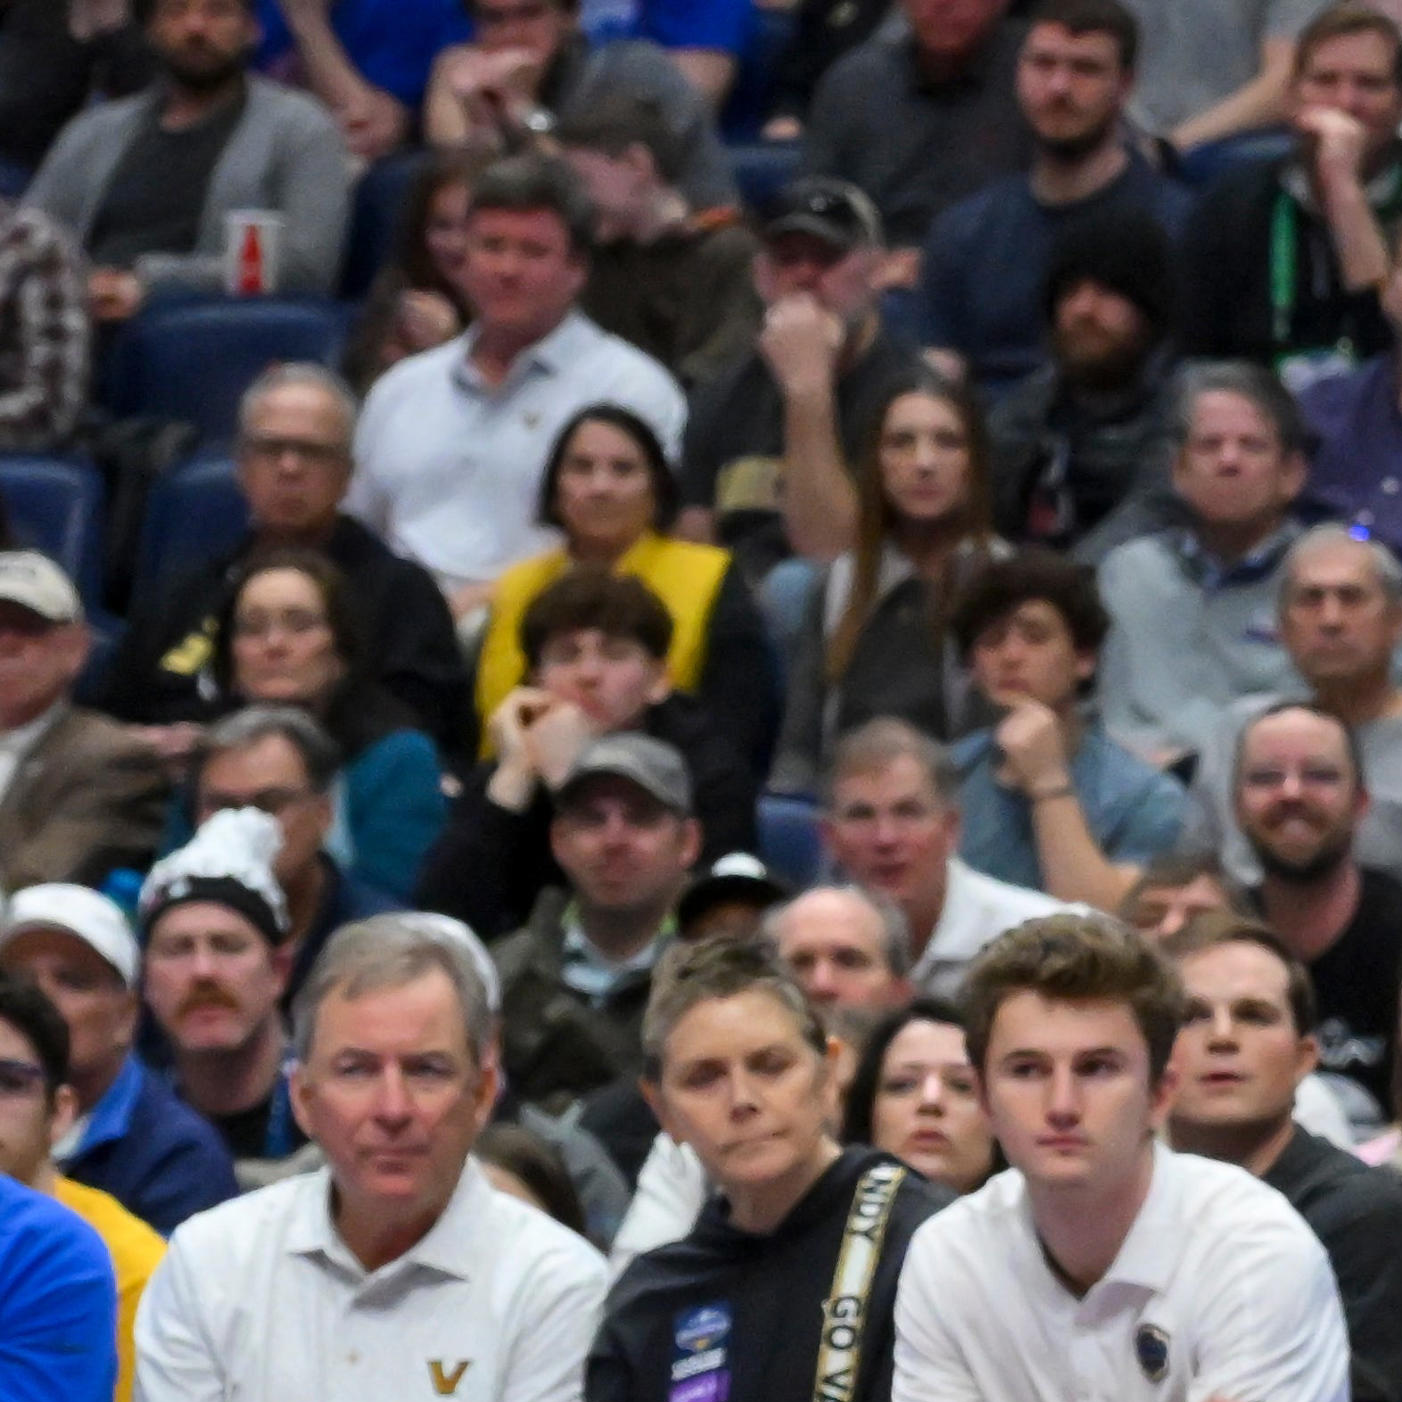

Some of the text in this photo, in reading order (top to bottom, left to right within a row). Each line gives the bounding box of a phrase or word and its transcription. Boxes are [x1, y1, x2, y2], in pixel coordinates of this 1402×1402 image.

[851, 1176, 893, 1241] NDY
[828, 1296, 861, 1350] GO
[426, 1358, 471, 1397] V
